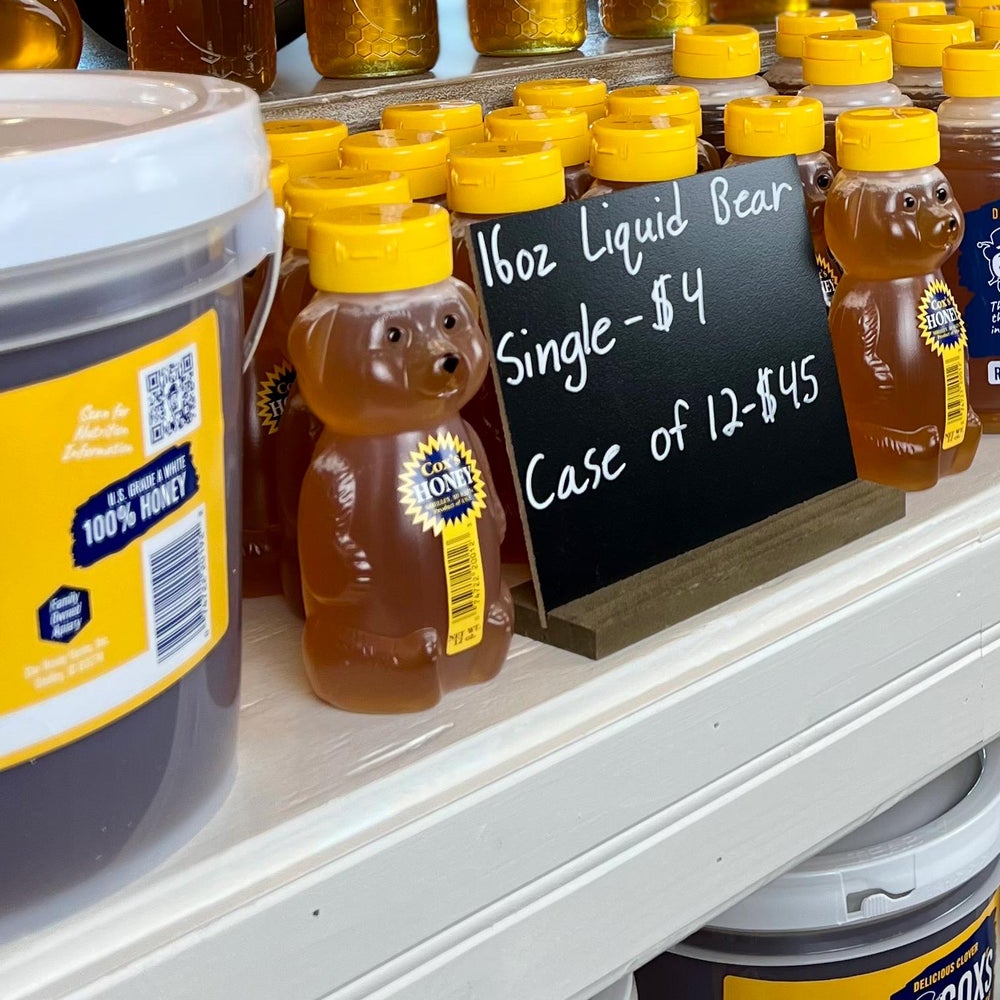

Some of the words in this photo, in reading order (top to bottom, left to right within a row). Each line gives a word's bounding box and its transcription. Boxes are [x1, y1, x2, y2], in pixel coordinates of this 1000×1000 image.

[476, 223, 557, 288] 16oz
[580, 181, 689, 276] Liquid
[710, 176, 793, 226] Bear
[413, 465, 474, 503] HONEY
[525, 443, 627, 510] Case
[650, 398, 690, 461] of
[82, 501, 137, 547] 100%
[139, 471, 188, 521] HONEY
[913, 962, 955, 993] DELICIOUS
[956, 942, 979, 969] CLOVER
